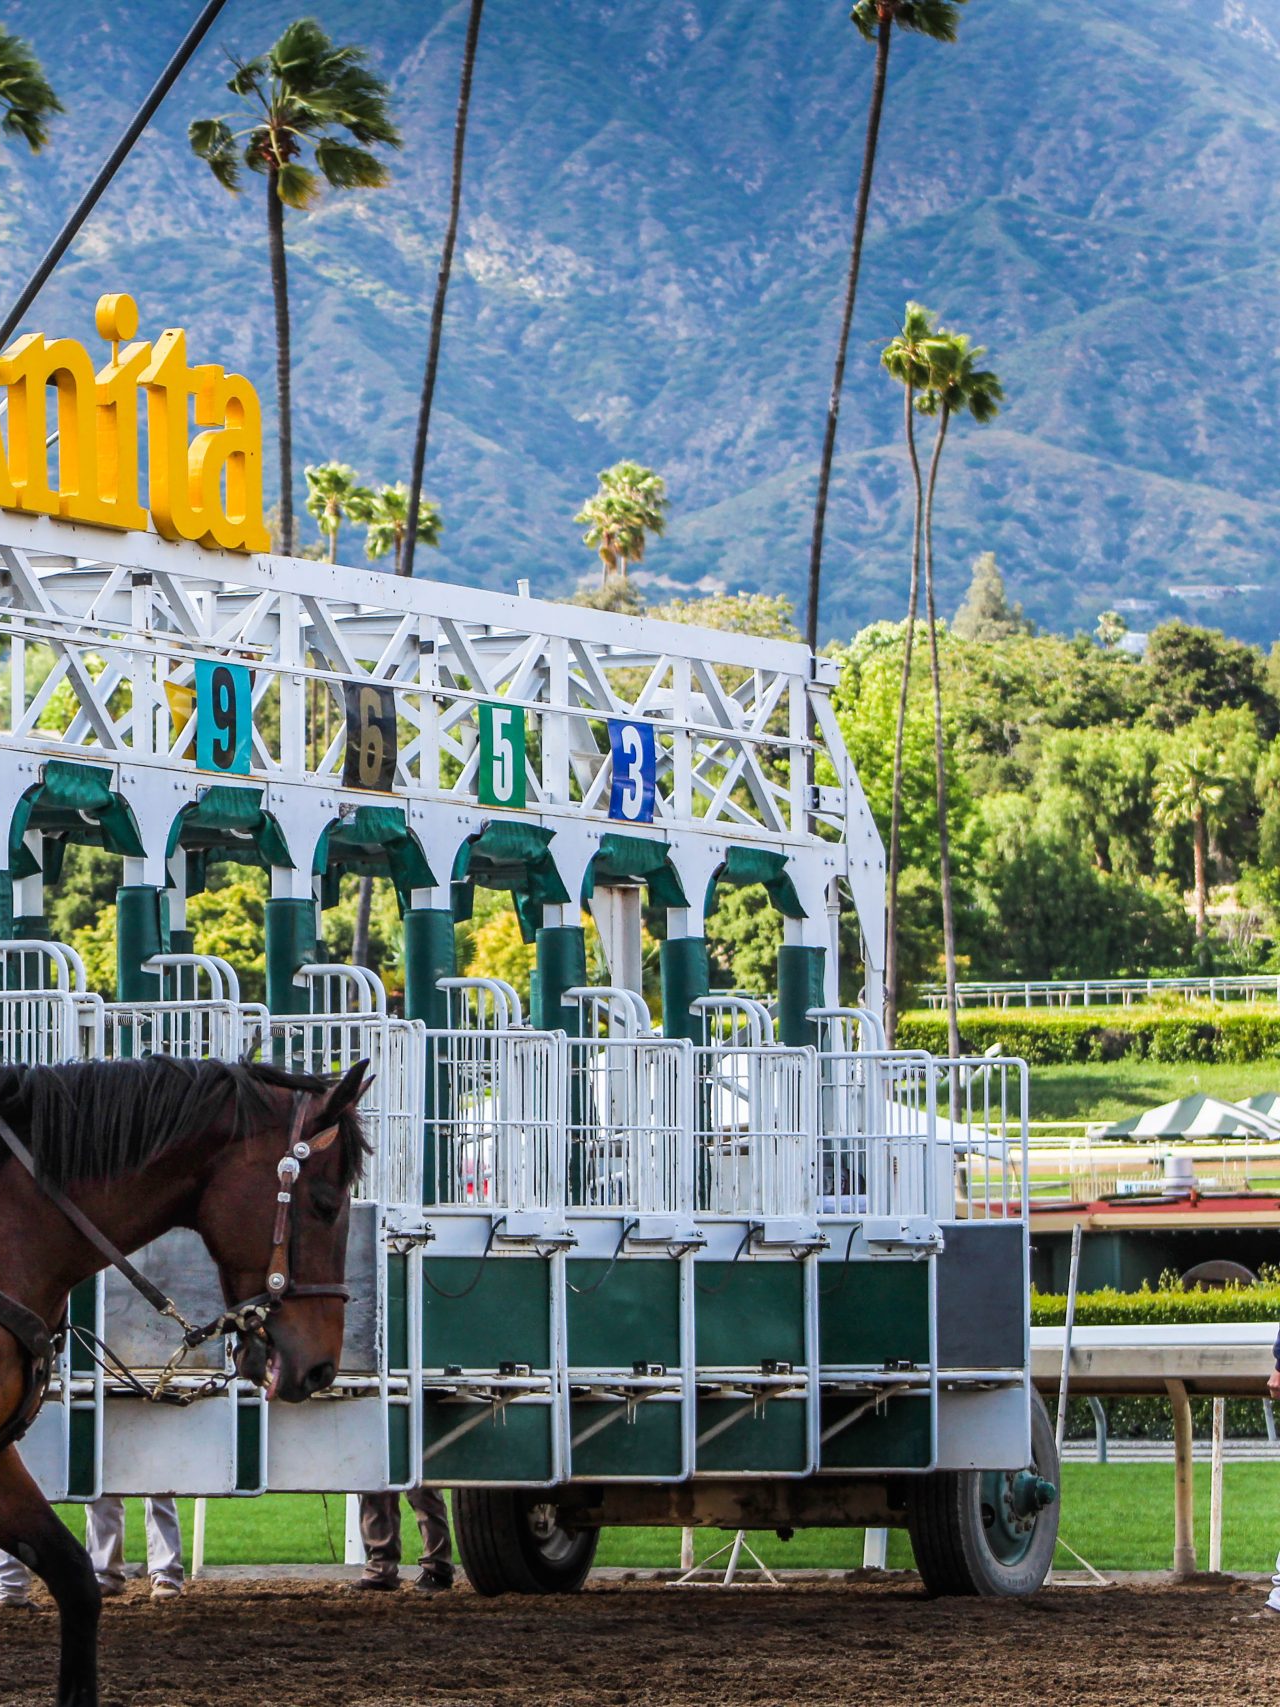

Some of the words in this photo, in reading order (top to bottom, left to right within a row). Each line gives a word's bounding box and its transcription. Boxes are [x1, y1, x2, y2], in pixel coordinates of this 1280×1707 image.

[211, 666, 237, 770] 9
[358, 686, 384, 787] 6
[491, 707, 514, 802] 5
[621, 725, 644, 820] 3
